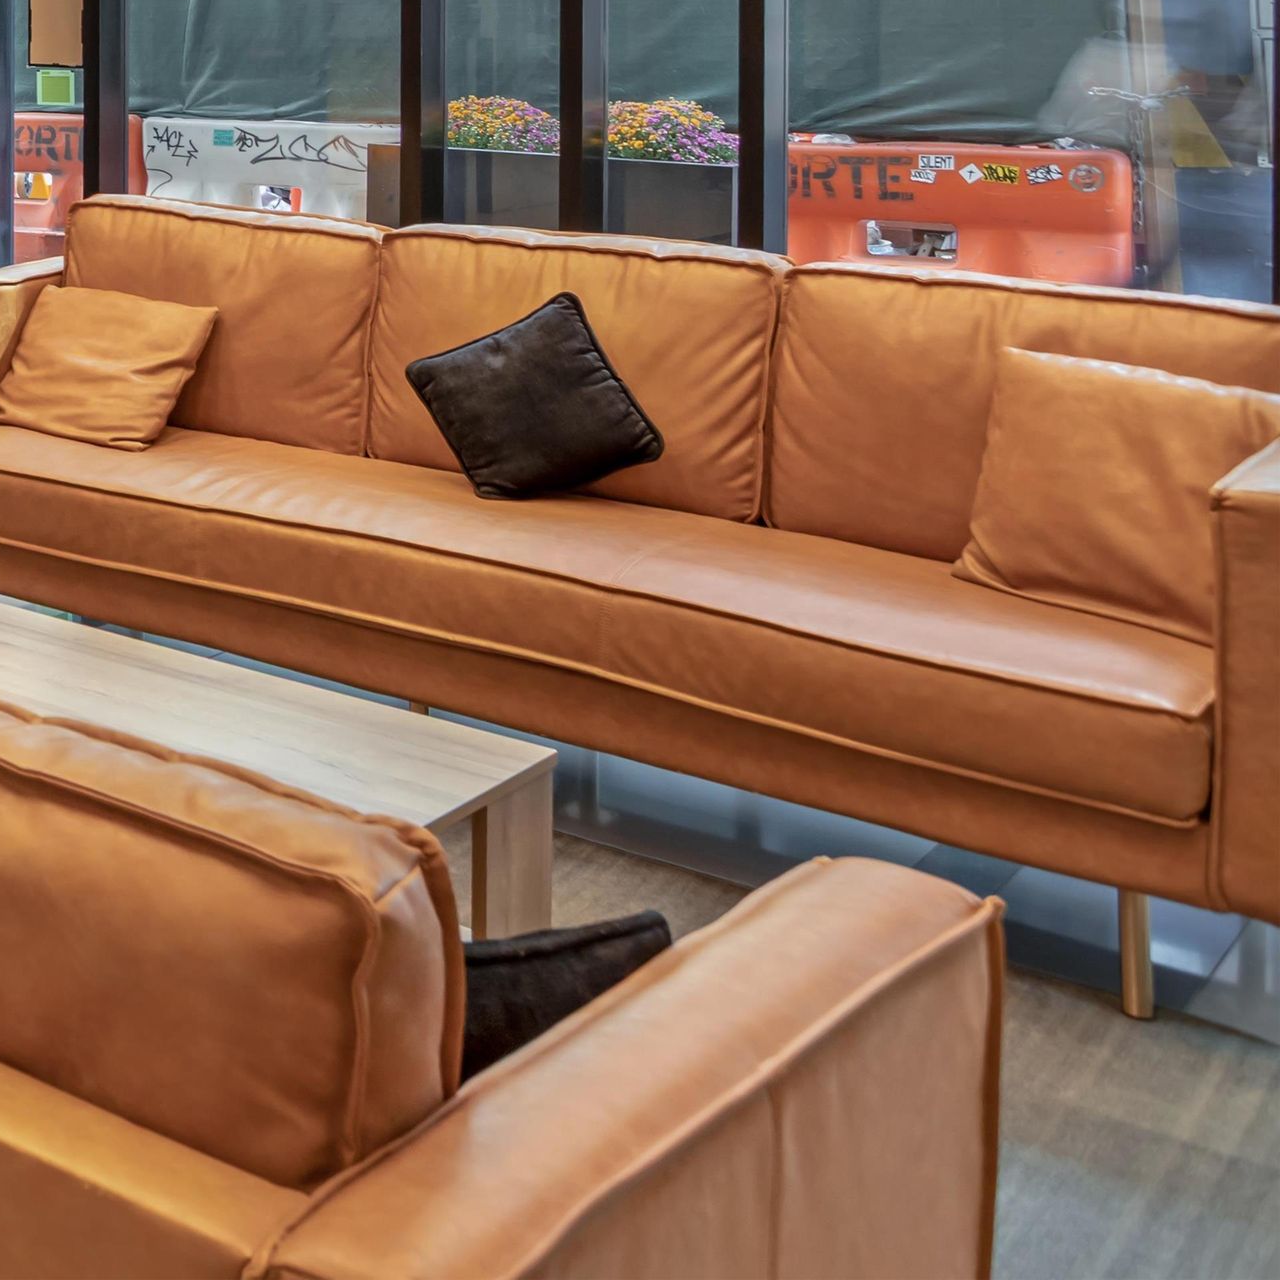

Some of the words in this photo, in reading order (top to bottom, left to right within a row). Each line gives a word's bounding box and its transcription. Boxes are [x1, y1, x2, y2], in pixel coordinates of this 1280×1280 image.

[15, 125, 84, 161] ORT
[789, 154, 914, 201] RTE
[920, 156, 952, 169] SILENT
